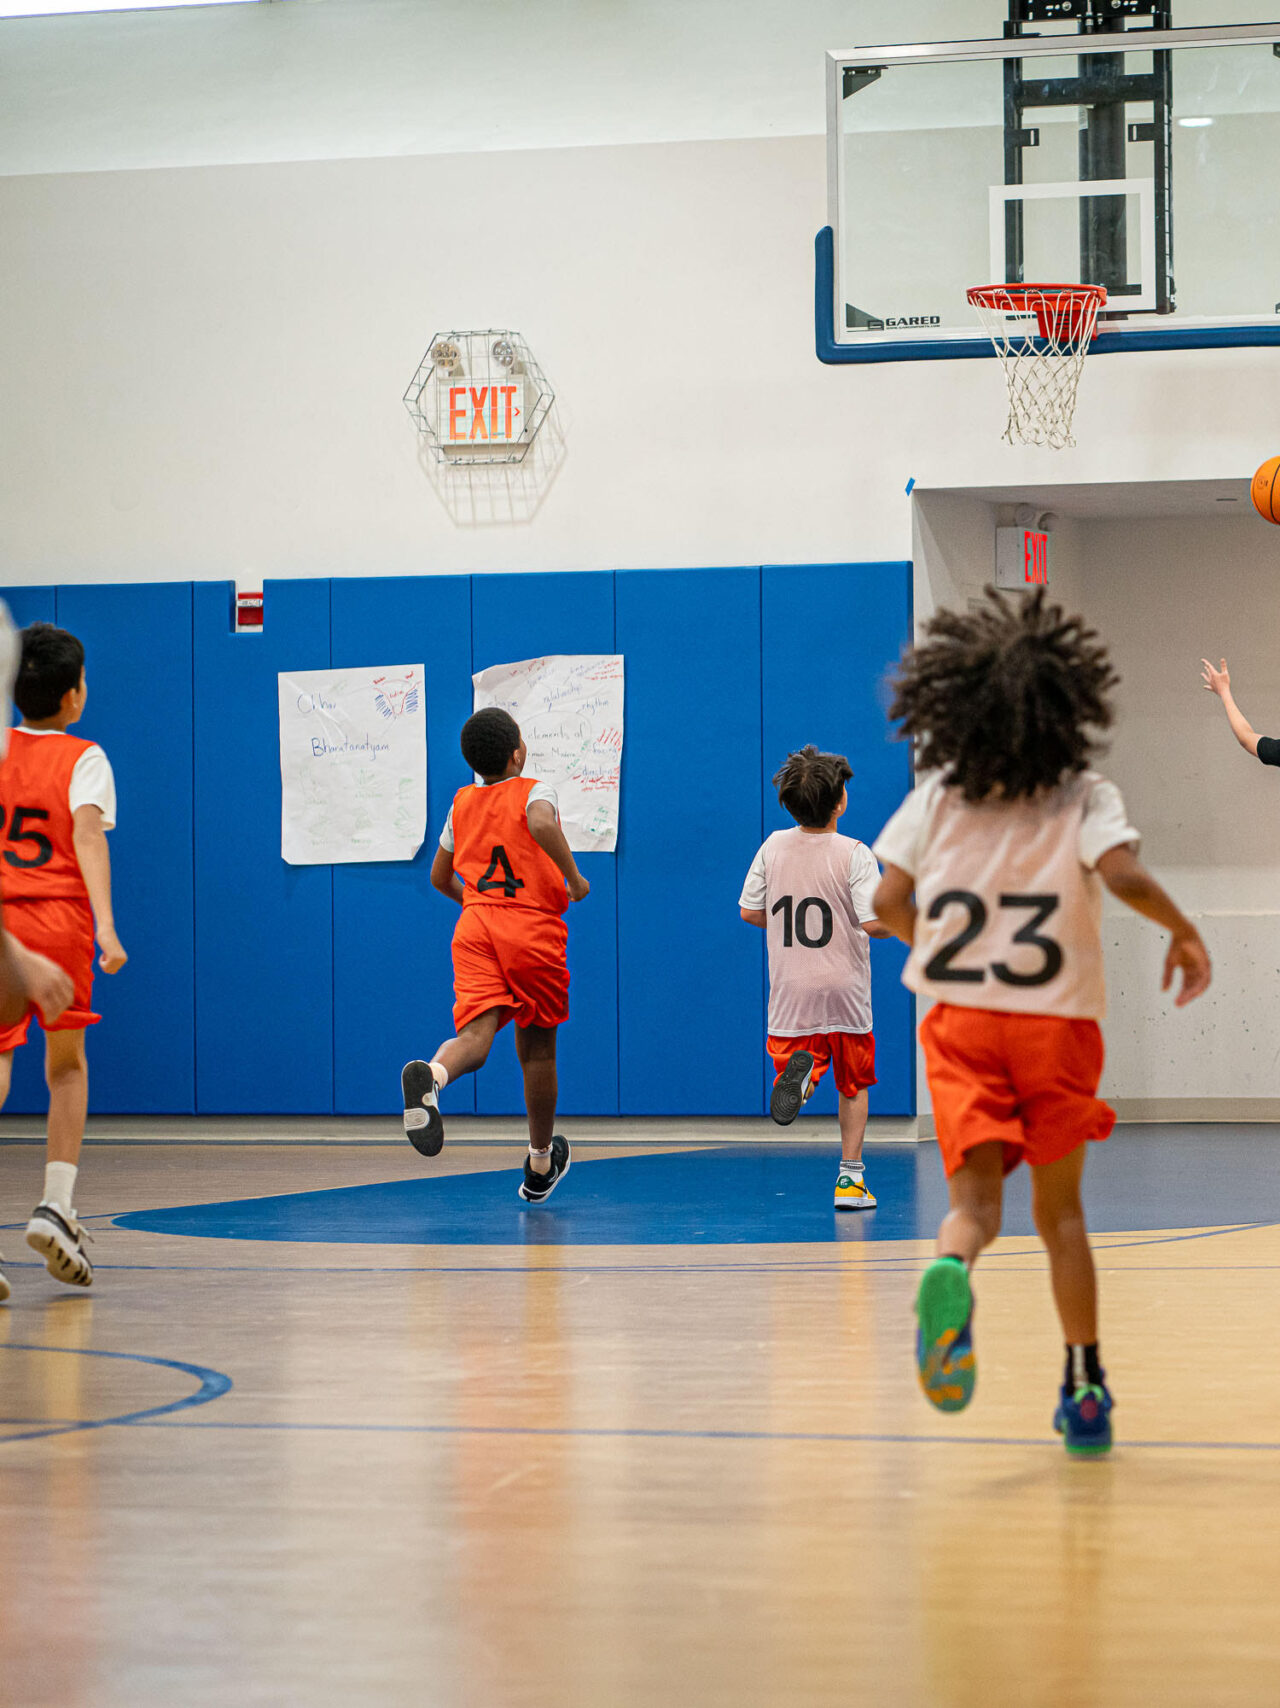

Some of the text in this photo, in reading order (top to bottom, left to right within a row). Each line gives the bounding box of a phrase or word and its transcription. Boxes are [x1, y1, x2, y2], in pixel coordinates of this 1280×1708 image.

[886, 315, 940, 327] GARED
[449, 386, 517, 440] EXIT
[1024, 530, 1048, 585] EXIT
[311, 732, 390, 762] Bharatanatyam
[0, 805, 53, 868] 5
[477, 845, 525, 897] 4
[771, 895, 833, 949] 10
[924, 889, 1063, 988] 23
